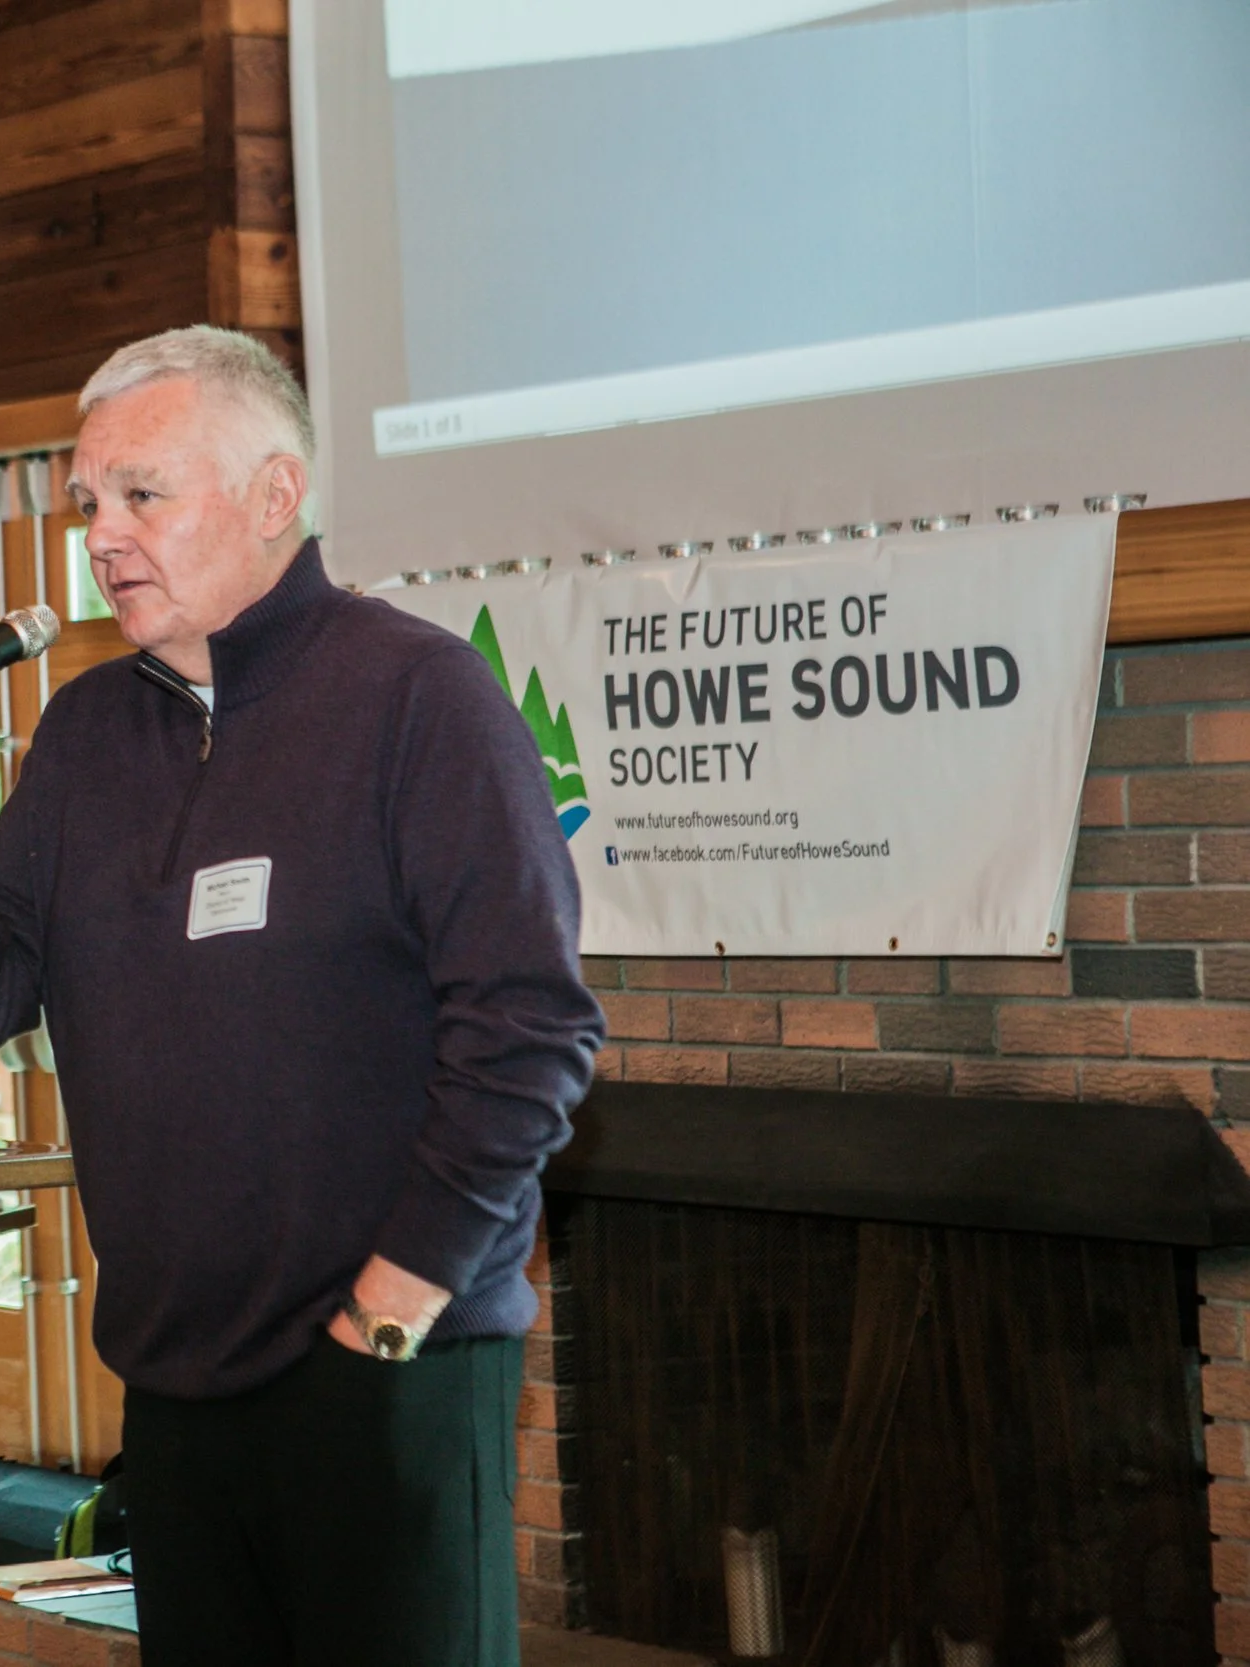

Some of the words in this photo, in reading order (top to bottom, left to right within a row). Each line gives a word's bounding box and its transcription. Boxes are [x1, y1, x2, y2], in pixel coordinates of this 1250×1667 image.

[603, 613, 668, 656] THE
[680, 599, 827, 650] FUTURE
[840, 593, 887, 637] OF
[604, 662, 771, 731] HOWE
[791, 645, 1020, 720] SOUND
[609, 742, 758, 787] SOCIETY
[614, 808, 799, 830] www.futureofhowesound.org
[620, 838, 890, 862] www.facebook.com/FutureofHoweSound
